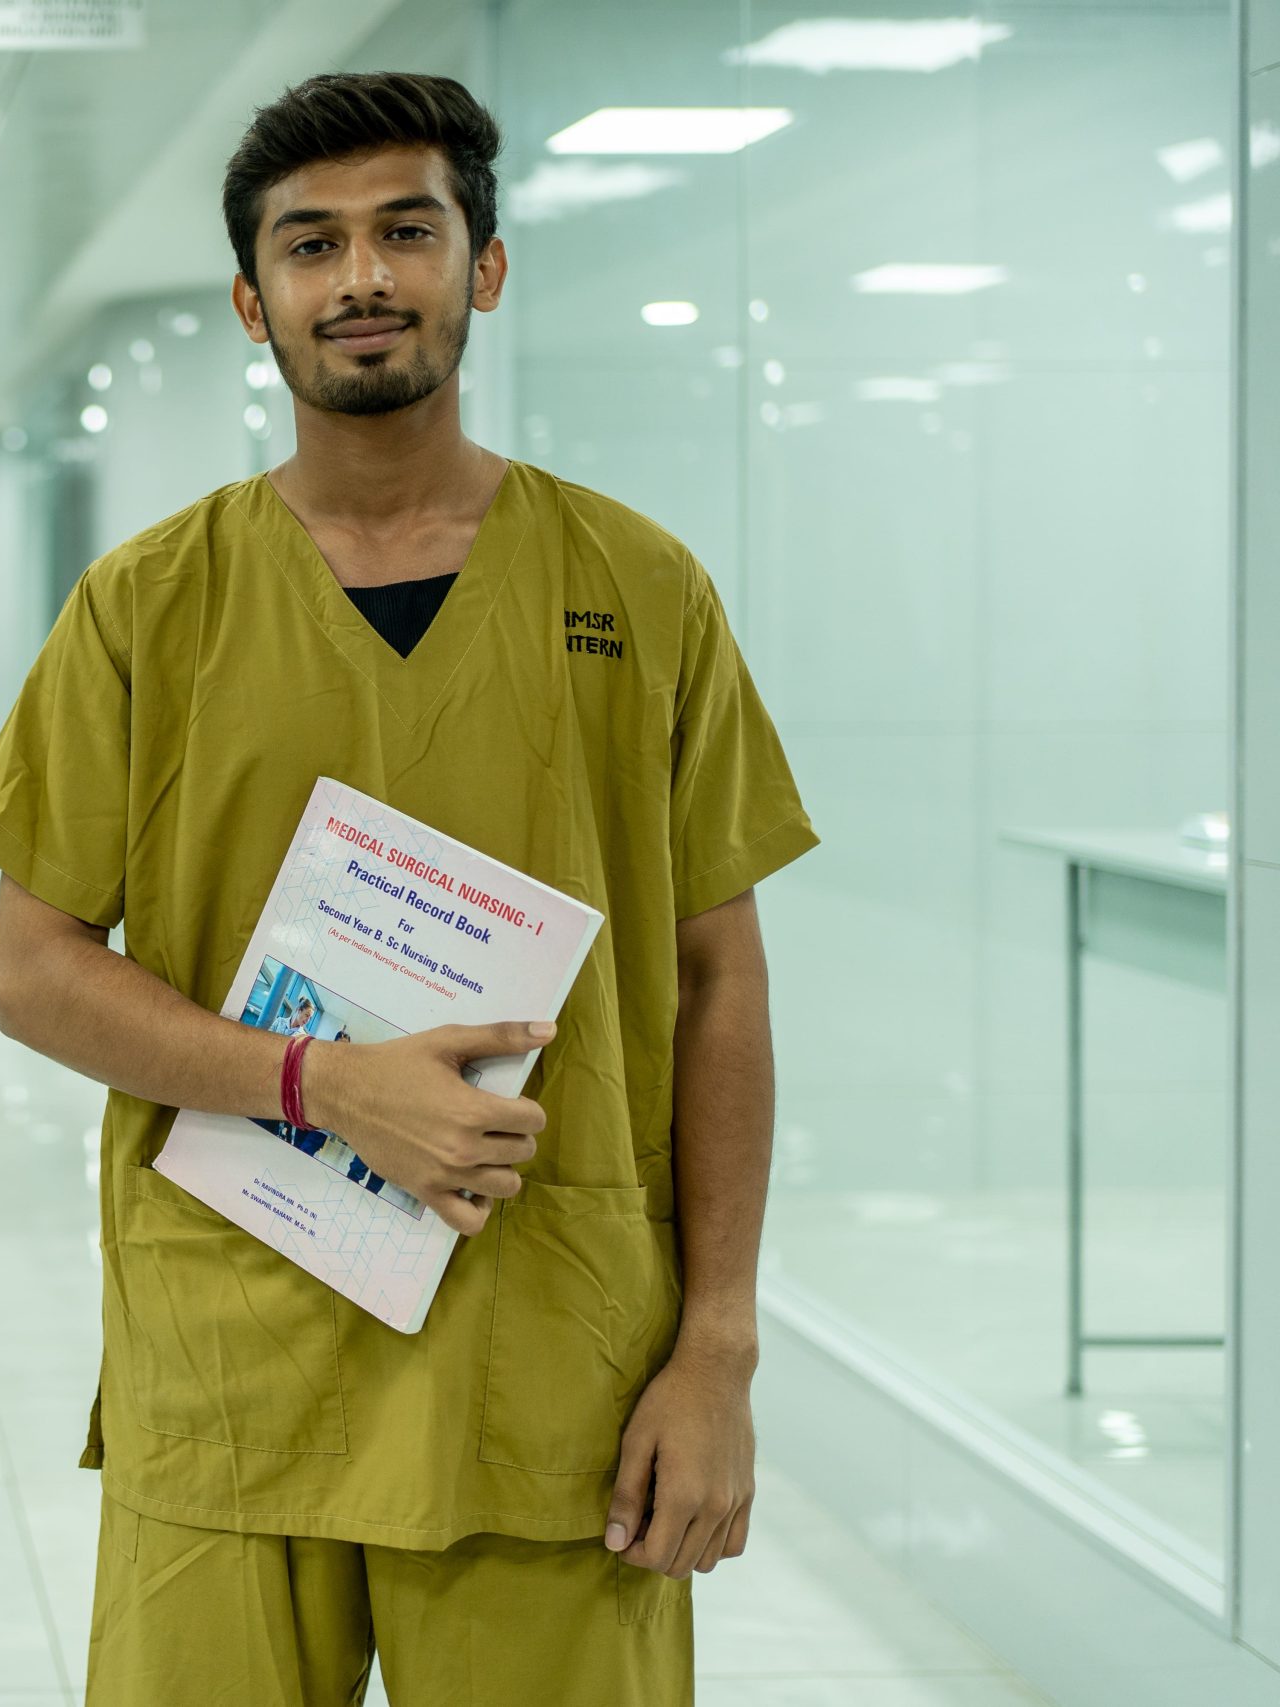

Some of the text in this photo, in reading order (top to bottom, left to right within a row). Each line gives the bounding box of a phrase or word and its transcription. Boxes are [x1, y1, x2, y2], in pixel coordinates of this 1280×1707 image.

[325, 816, 384, 858] MEDICAL
[387, 848, 454, 893] SURGICAL
[457, 883, 525, 927] NURSING
[535, 921, 544, 936] I
[346, 859, 491, 944] Practical Record Book
[318, 899, 484, 994] Second Year B. Sc Nursing Students
[327, 926, 457, 1000] (As per Indian Nursing Council syllabus)
[397, 918, 415, 934] For
[261, 1182, 286, 1201] RAVINDRA
